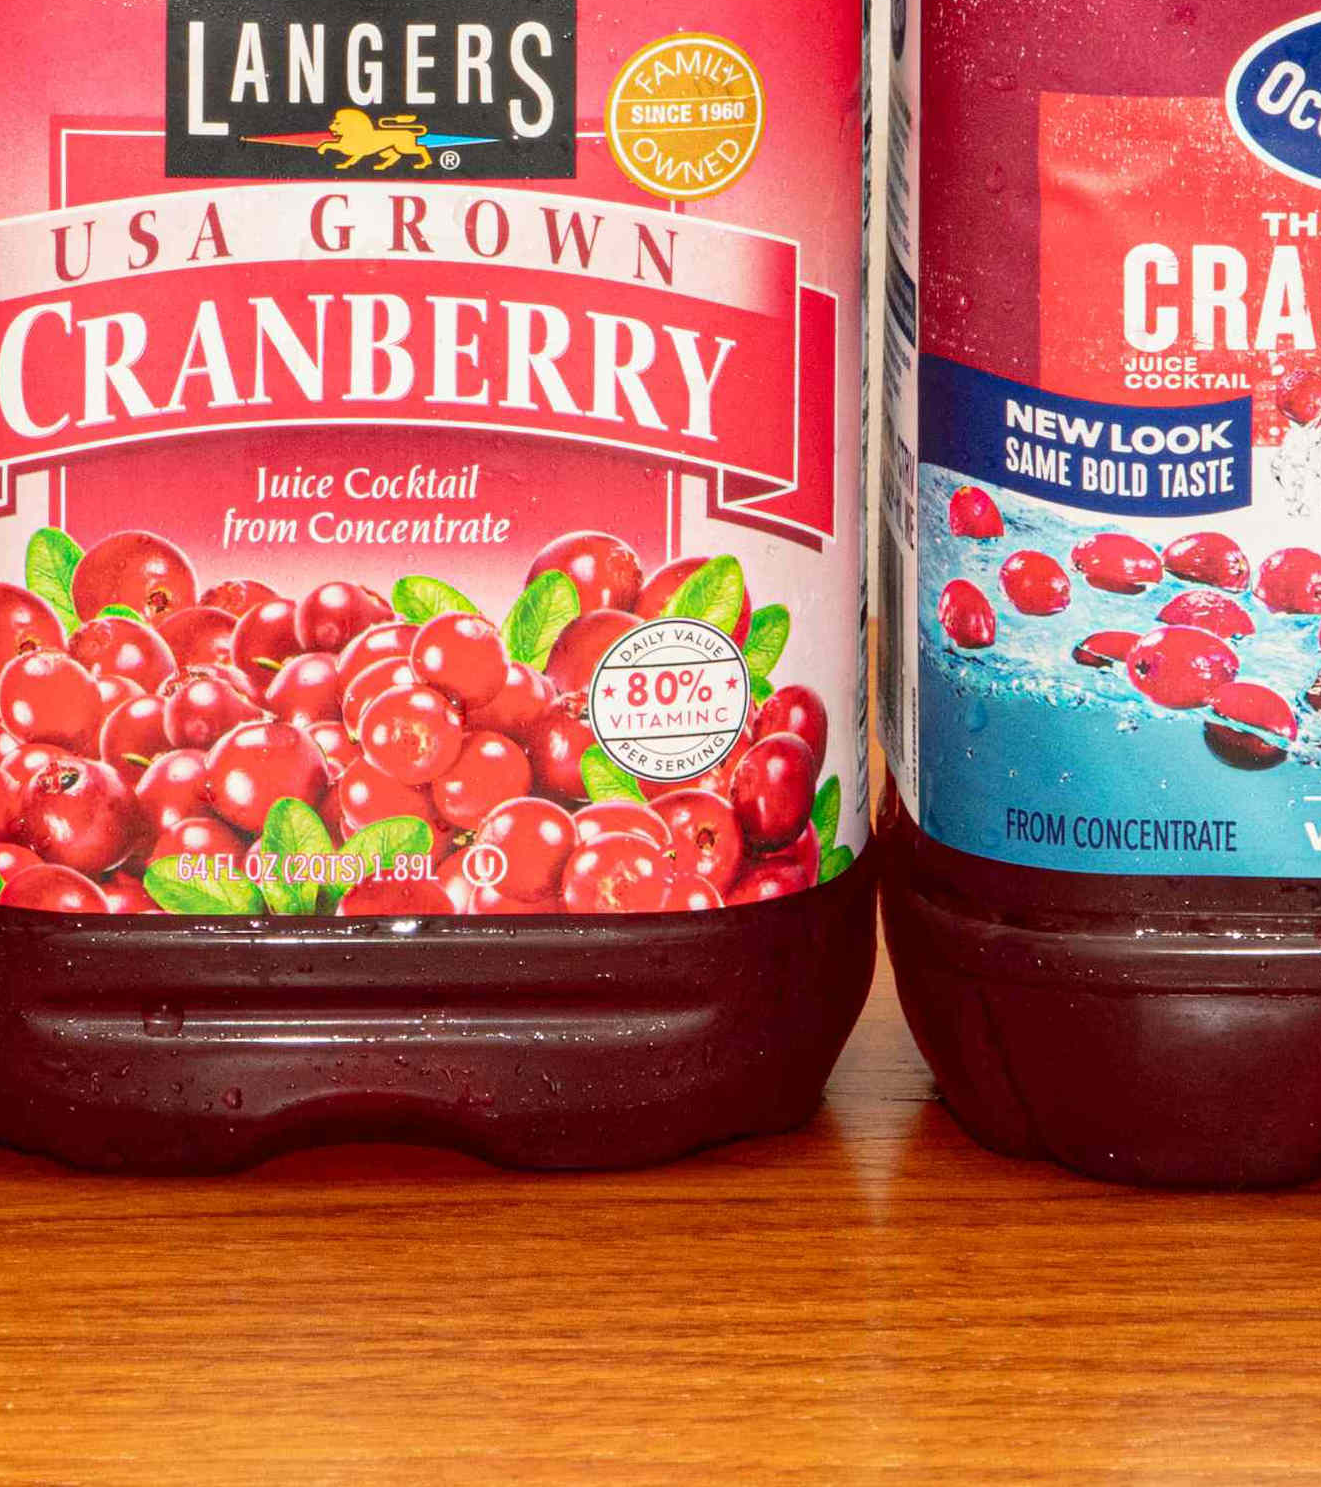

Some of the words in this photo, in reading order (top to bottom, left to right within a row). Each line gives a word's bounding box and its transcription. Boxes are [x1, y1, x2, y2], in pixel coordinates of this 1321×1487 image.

[187, 19, 556, 141] LANGERS
[634, 49, 744, 95] FAMILY
[631, 104, 693, 124] SINCE
[699, 101, 747, 122] 1960
[632, 137, 741, 184] OWNED
[48, 200, 237, 282] USA
[309, 192, 680, 288] GROWN
[1124, 356, 1198, 373] JUICE
[1124, 373, 1252, 390] COCKTAIL
[1005, 399, 1104, 448] NEW
[1110, 419, 1234, 455] LOOK
[255, 466, 335, 503] Juice
[343, 464, 480, 500] Cocktail
[1005, 436, 1072, 487] SAME
[1081, 456, 1149, 498] BOLD
[1158, 456, 1235, 498] TASTE
[221, 507, 297, 550] from
[307, 511, 511, 544] Concentrate
[619, 630, 666, 663] DAILY
[673, 628, 724, 659] VALUE
[626, 668, 713, 707] 80%
[618, 741, 649, 768] PER
[654, 735, 727, 773] SERVING
[1005, 807, 1067, 847] FROM
[1072, 816, 1238, 853] CONCENTRATE
[177, 853, 208, 881] 64
[213, 854, 241, 881] FL
[244, 853, 278, 881] OZ
[284, 852, 366, 883] (2QTS)
[371, 853, 439, 882] 1.89L
